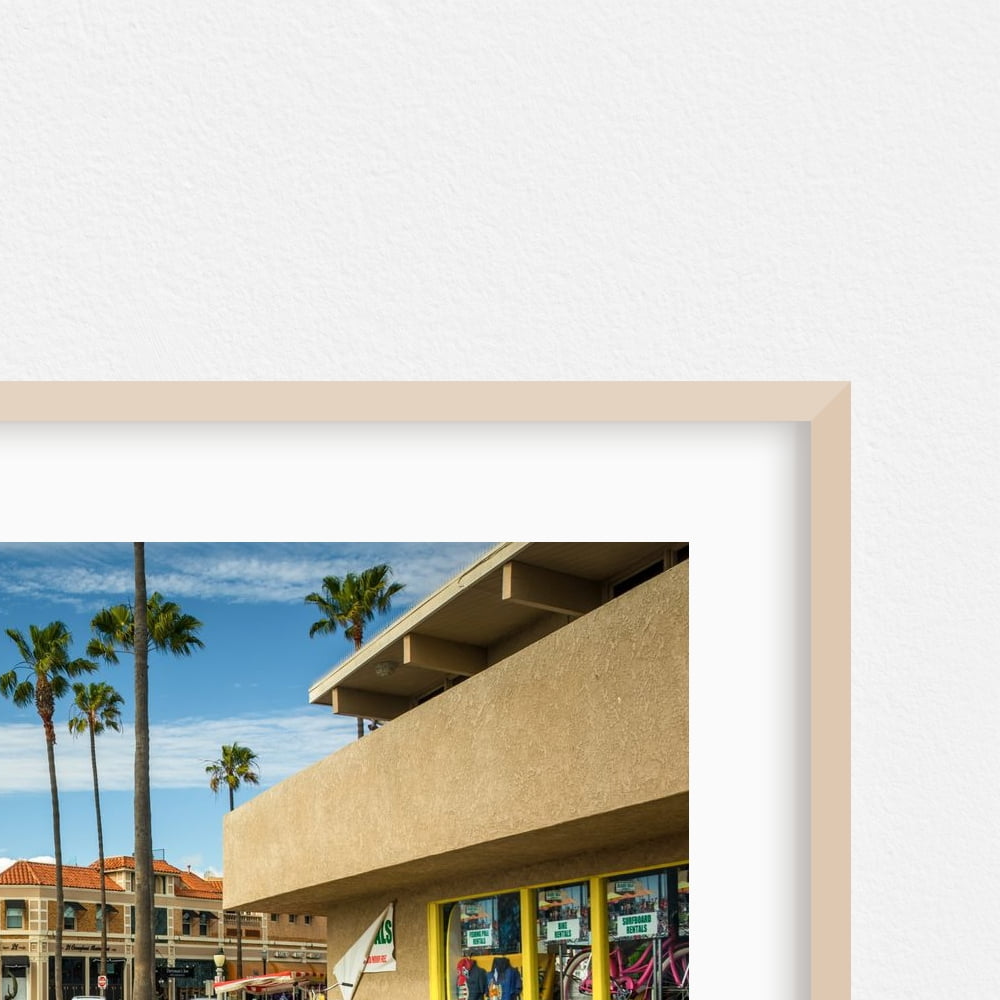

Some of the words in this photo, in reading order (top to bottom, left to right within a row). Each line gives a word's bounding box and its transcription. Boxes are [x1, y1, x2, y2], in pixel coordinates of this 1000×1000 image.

[622, 914, 651, 925] SURFBOARD
[554, 930, 571, 938] RENTALS
[626, 925, 647, 934] RENTALS
